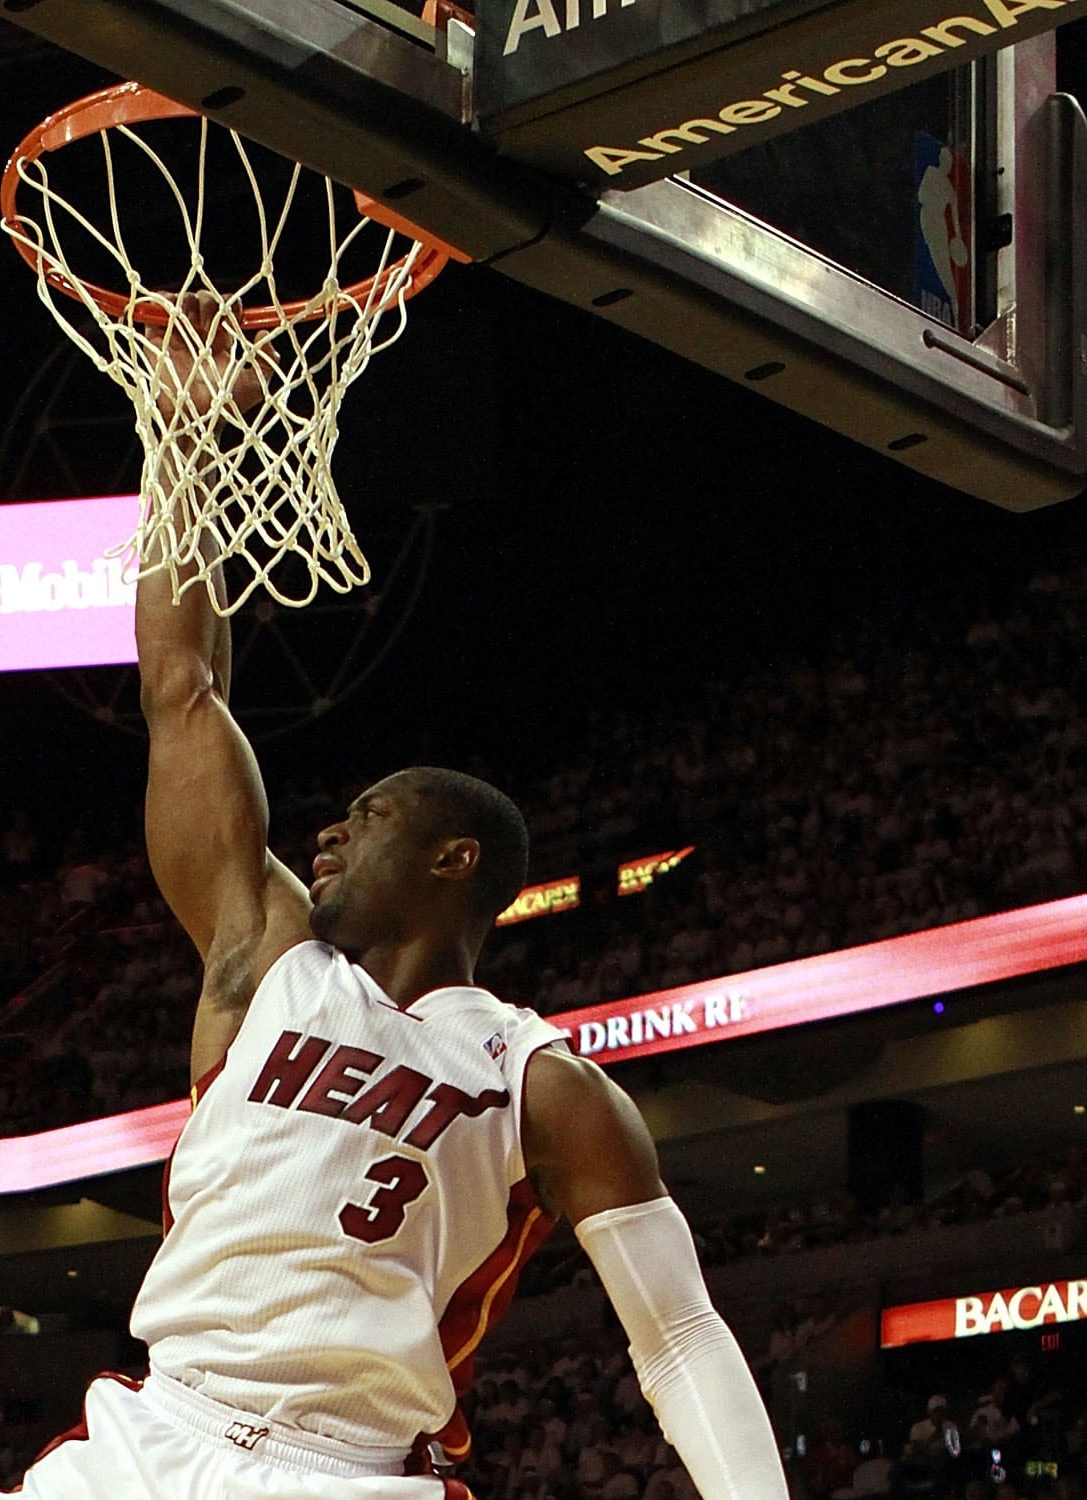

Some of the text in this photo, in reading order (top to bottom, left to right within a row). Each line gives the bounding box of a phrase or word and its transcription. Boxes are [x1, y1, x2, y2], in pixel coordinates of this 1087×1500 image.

[583, 0, 1074, 176] AmericanA
[579, 1000, 697, 1055] DRINK
[247, 1030, 510, 1152] HEAT
[338, 1154, 428, 1244] 3
